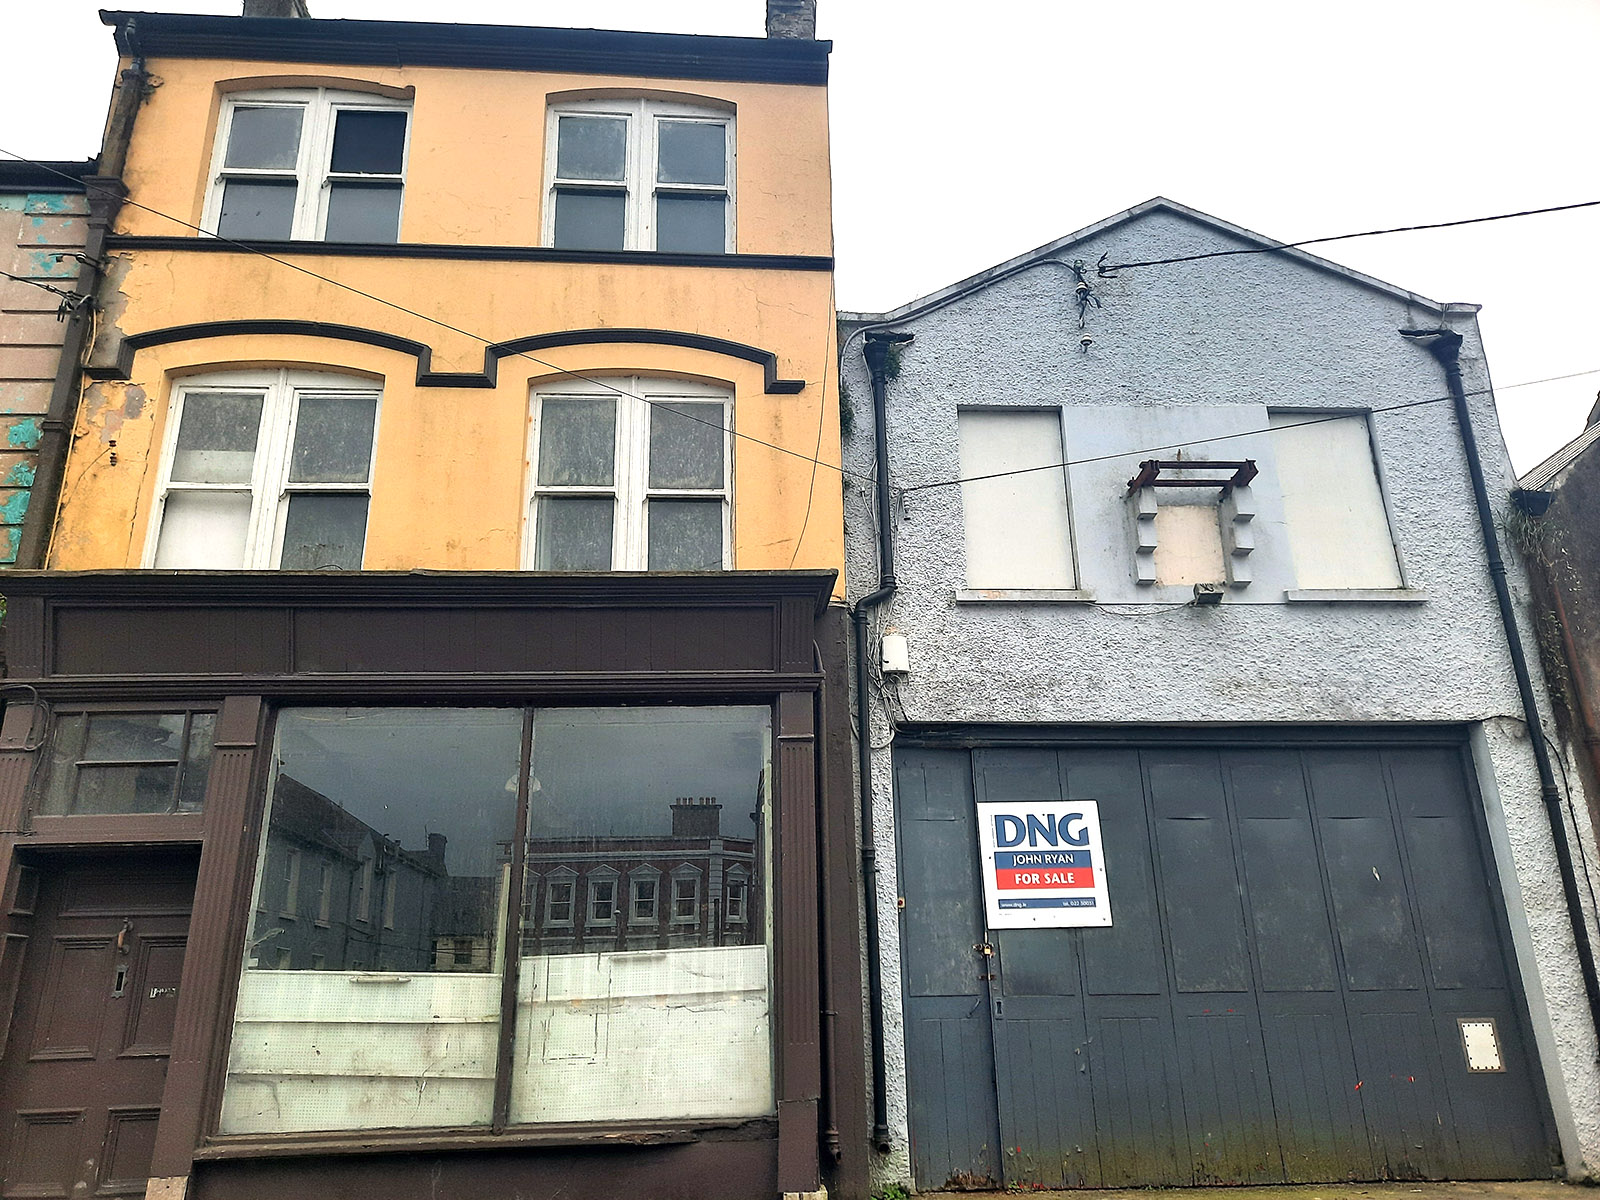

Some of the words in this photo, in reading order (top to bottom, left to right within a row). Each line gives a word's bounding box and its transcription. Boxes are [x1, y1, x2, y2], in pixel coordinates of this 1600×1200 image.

[994, 813, 1090, 847] DNG
[1013, 854, 1042, 866] JOHN
[1044, 853, 1074, 864] RYAN
[1015, 873, 1041, 884] FOR
[1044, 872, 1075, 884] SALE
